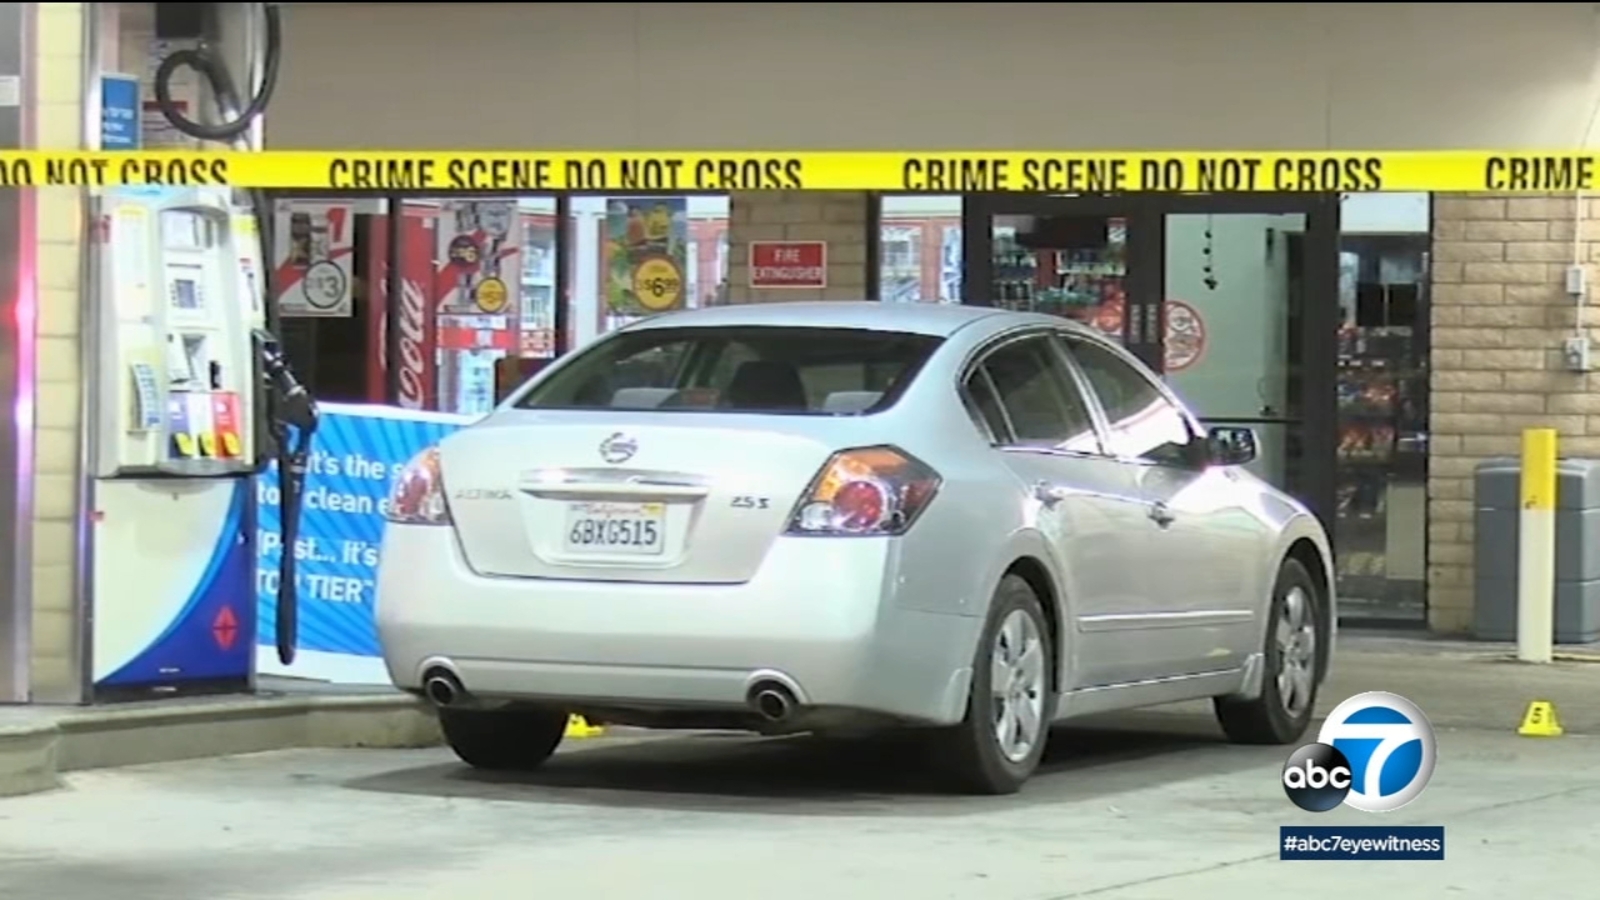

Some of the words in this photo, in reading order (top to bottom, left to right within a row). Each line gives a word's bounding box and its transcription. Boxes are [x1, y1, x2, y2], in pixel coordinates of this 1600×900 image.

[46, 159, 109, 185] NOT
[121, 158, 228, 185] CROSS
[329, 159, 434, 189] CRIME
[448, 159, 552, 189] SCENE
[565, 159, 606, 189] DO
[621, 159, 684, 189] NOT
[695, 159, 802, 189] CROSS
[903, 158, 1009, 190] CRIME
[1022, 158, 1128, 190] SCENE
[1140, 158, 1184, 190] DO
[1198, 158, 1262, 190] NOT
[1274, 158, 1382, 190] CROSS
[1485, 157, 1594, 189] CRIME
[774, 249, 801, 263] FIRE
[345, 453, 386, 480] the
[304, 486, 373, 515] clean
[569, 519, 657, 546] 6BXG515
[342, 541, 378, 568] It's
